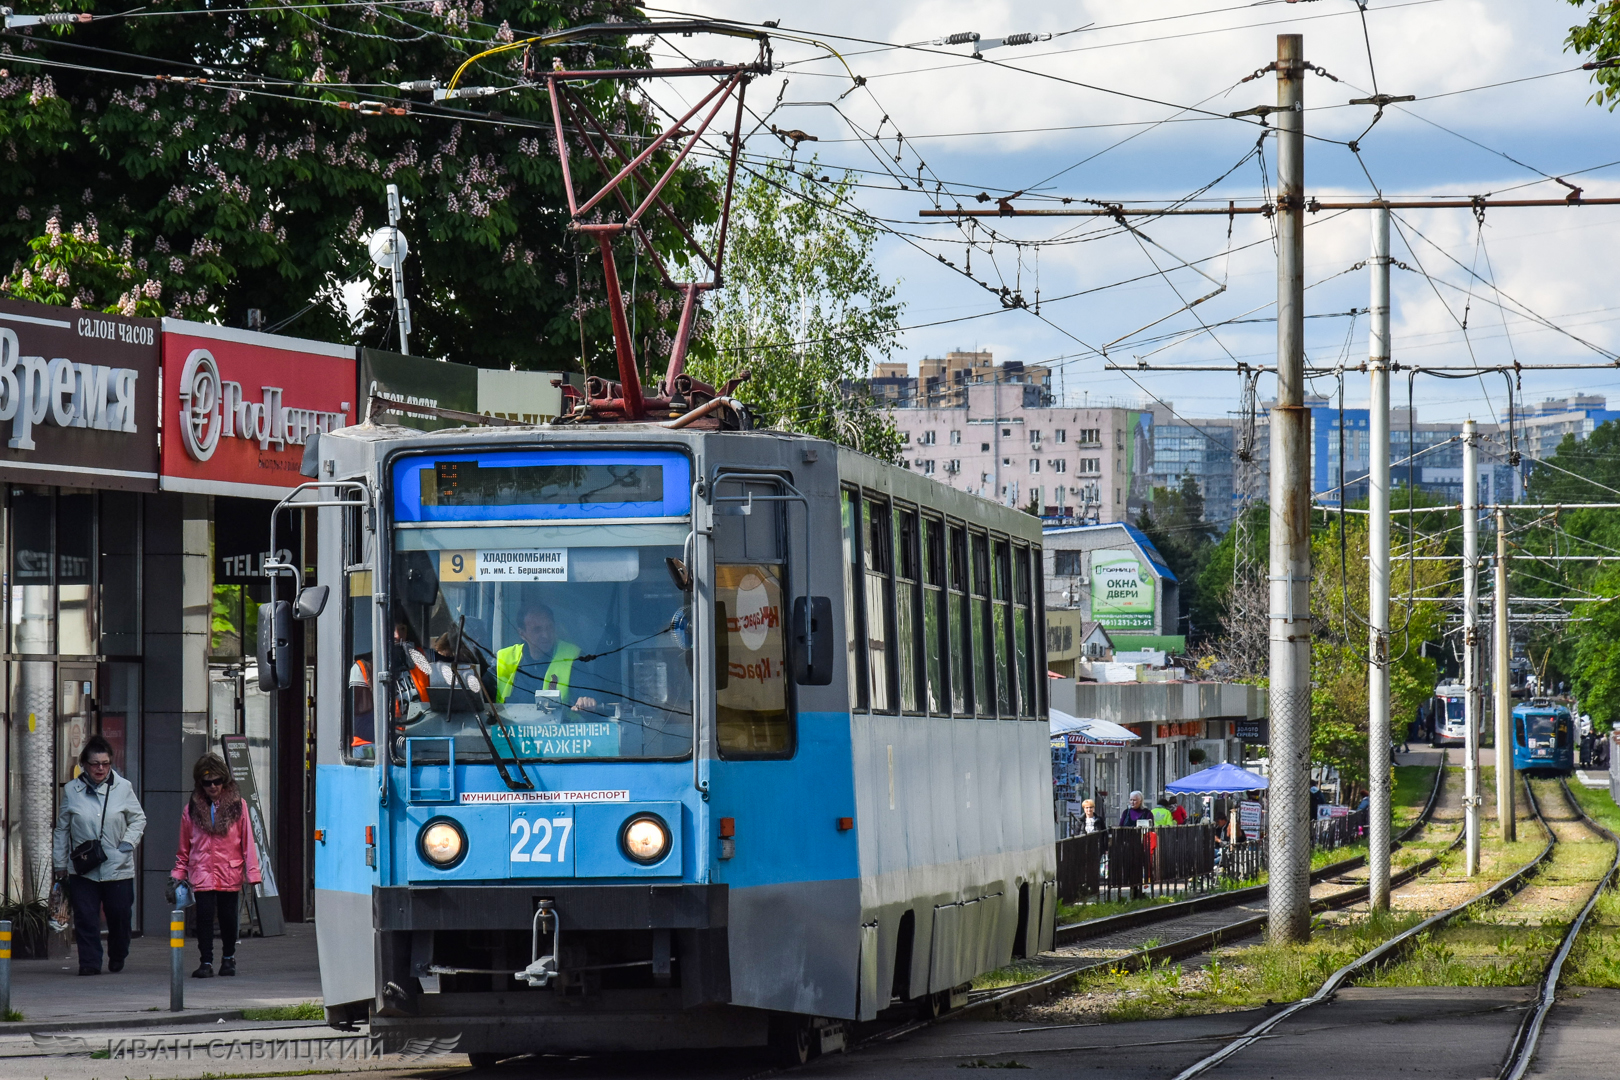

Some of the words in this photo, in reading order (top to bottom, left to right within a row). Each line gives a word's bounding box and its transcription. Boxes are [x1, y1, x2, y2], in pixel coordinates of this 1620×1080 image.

[77, 315, 115, 340] салон
[118, 320, 154, 346] часов
[0, 327, 138, 451] Время
[452, 554, 464, 573] 9
[482, 552, 562, 563] ХЛАДОКОМБИНАТ
[480, 567, 491, 576] ул.
[493, 567, 505, 575] им.
[508, 567, 515, 575] Е.
[518, 566, 565, 576] Бершанской
[1107, 579, 1138, 589] ОКНА
[1106, 590, 1139, 600] ДВЕРИ
[497, 725, 516, 738] ЗА
[518, 723, 610, 738] УПРАВЛЕНИЕМ
[521, 739, 592, 755] СТАЖЕР
[462, 790, 561, 802] МУНИЦИПАЛЬНЫЙ
[563, 789, 627, 801] ТРАНСПОРТ
[510, 817, 573, 863] 227
